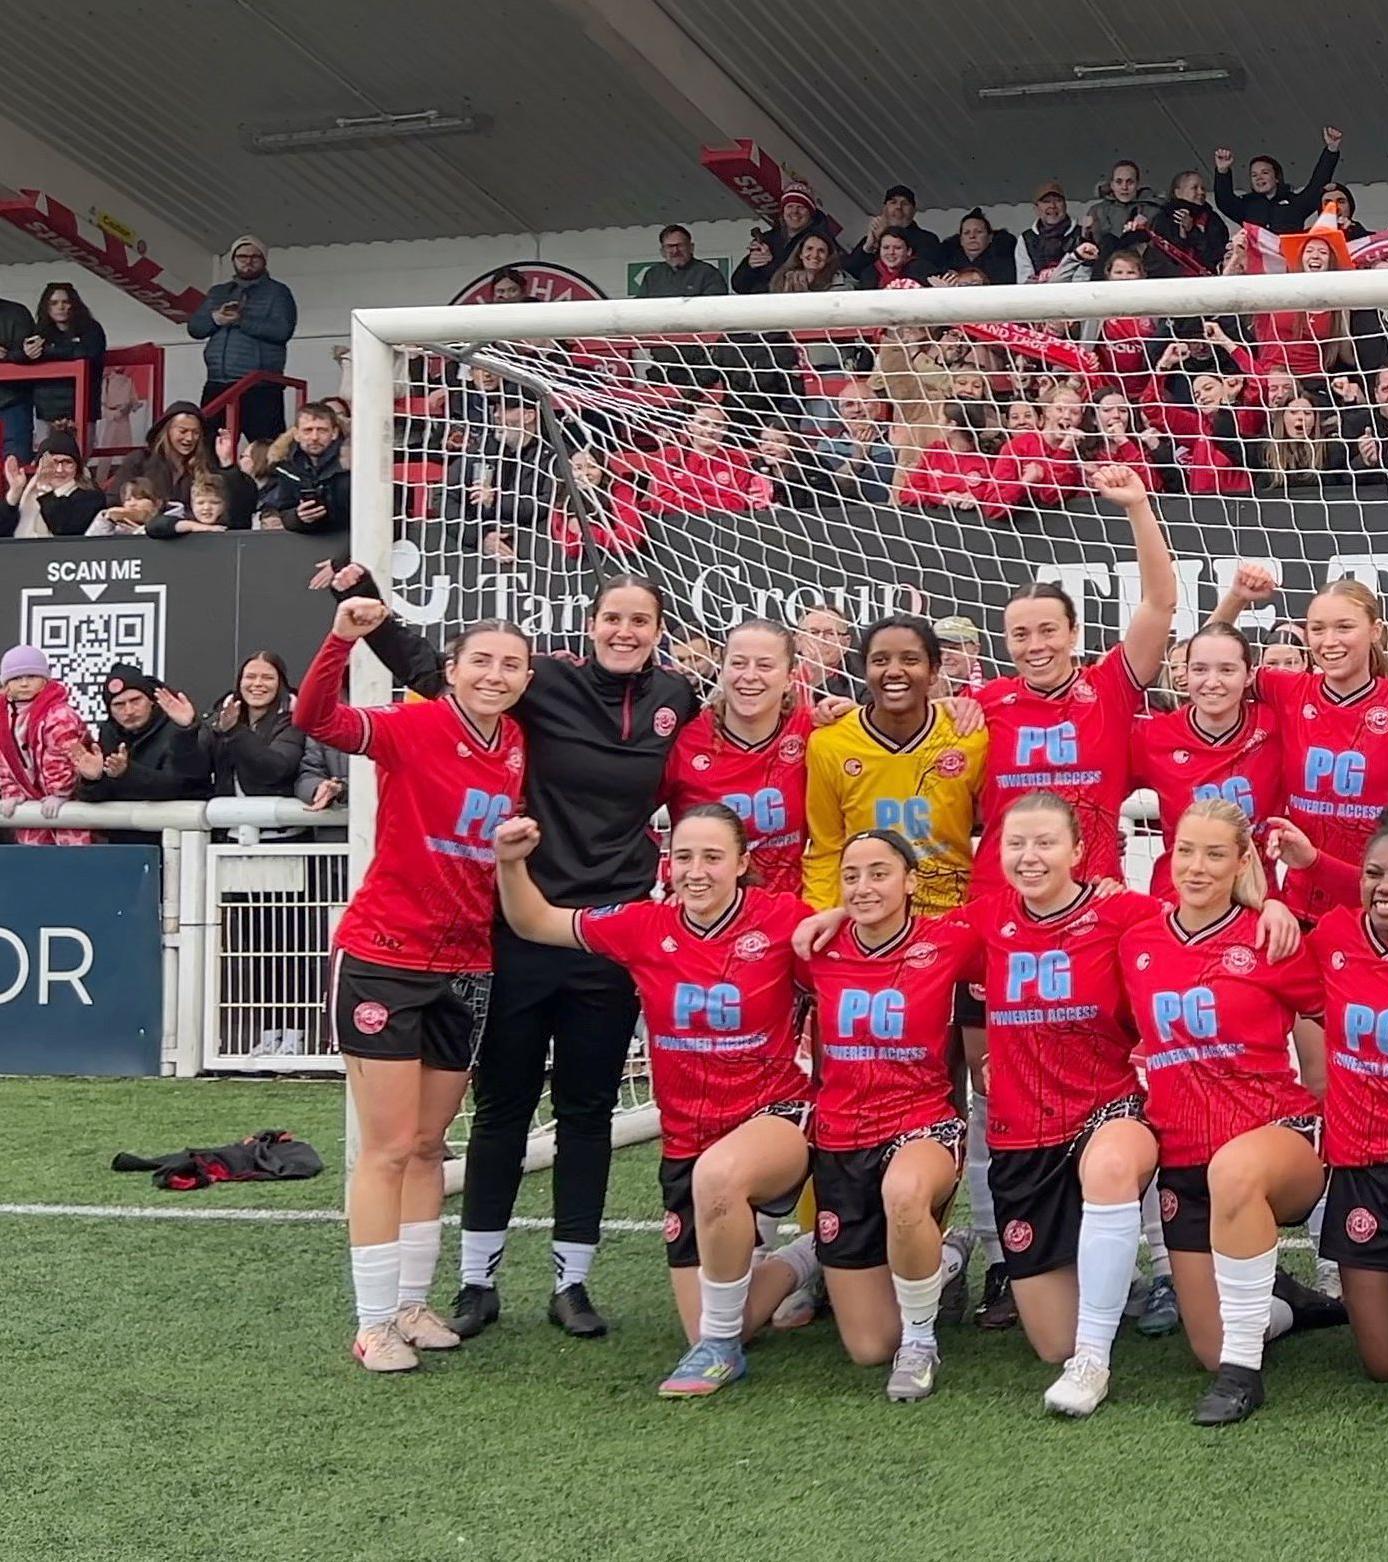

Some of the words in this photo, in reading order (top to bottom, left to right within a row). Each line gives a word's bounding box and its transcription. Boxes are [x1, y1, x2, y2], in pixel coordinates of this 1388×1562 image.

[47, 560, 106, 582] SCAN
[111, 559, 142, 580] ME
[1016, 720, 1078, 766] PG
[1305, 745, 1367, 797] PG
[455, 787, 512, 838] PG
[875, 797, 931, 840] PG
[1007, 950, 1072, 1003] PG
[675, 981, 742, 1032] PG
[838, 988, 906, 1041] PG
[1152, 985, 1219, 1043] PG
